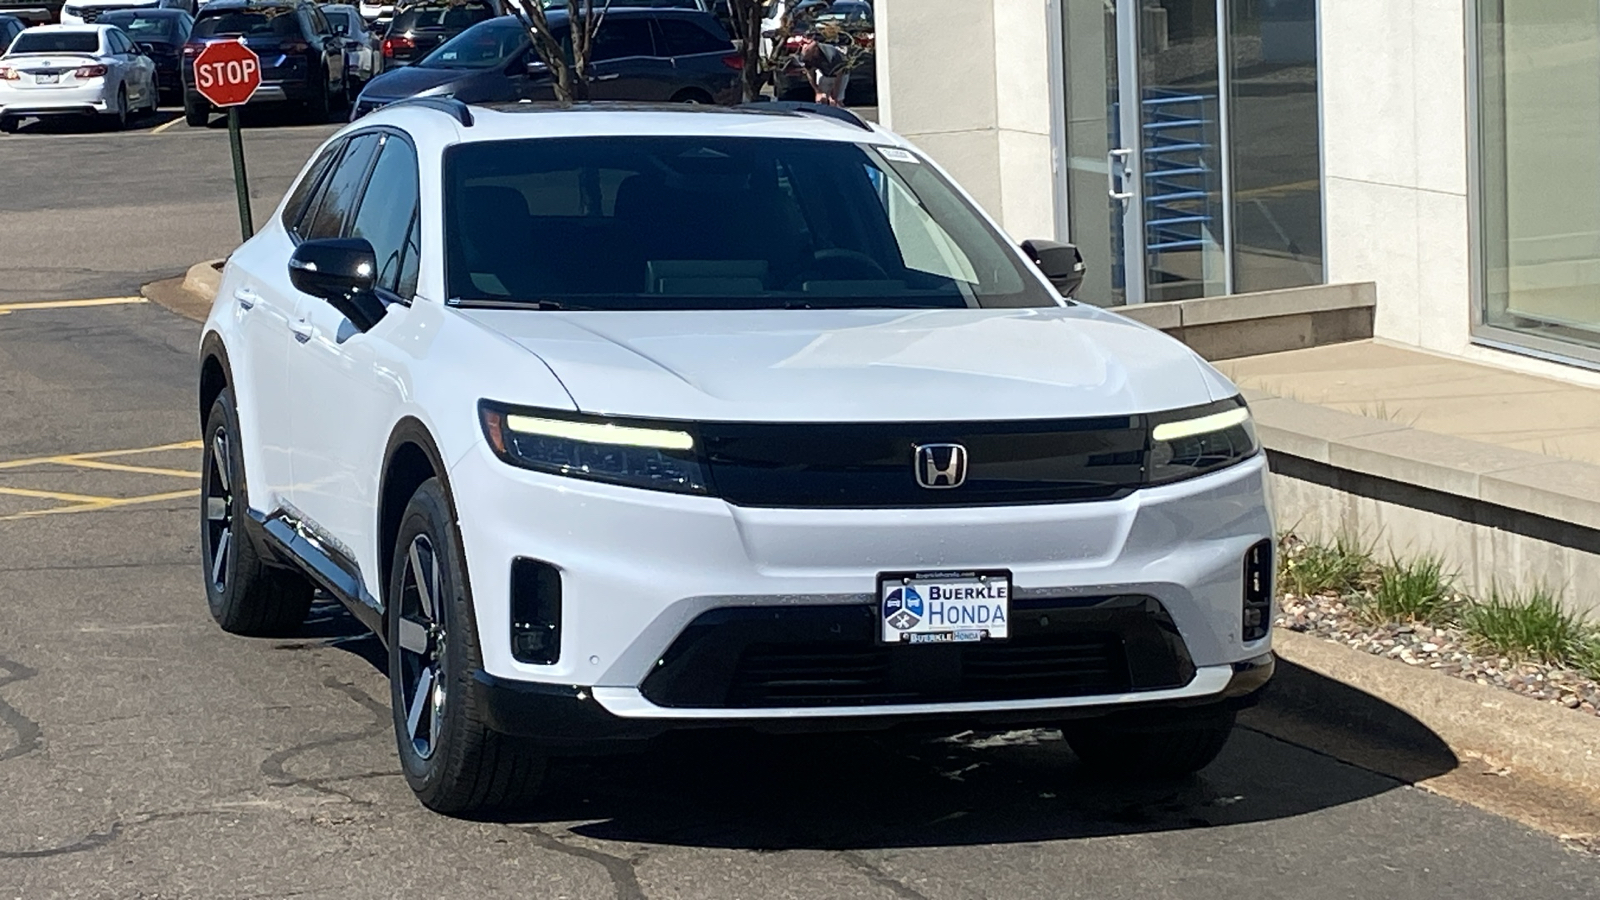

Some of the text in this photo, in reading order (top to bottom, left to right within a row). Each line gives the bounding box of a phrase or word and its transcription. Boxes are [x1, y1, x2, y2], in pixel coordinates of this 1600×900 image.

[200, 59, 256, 88] STOP
[929, 586, 1007, 600] BUERKLE
[929, 602, 1005, 625] HONDA
[911, 632, 952, 643] BUERKLE
